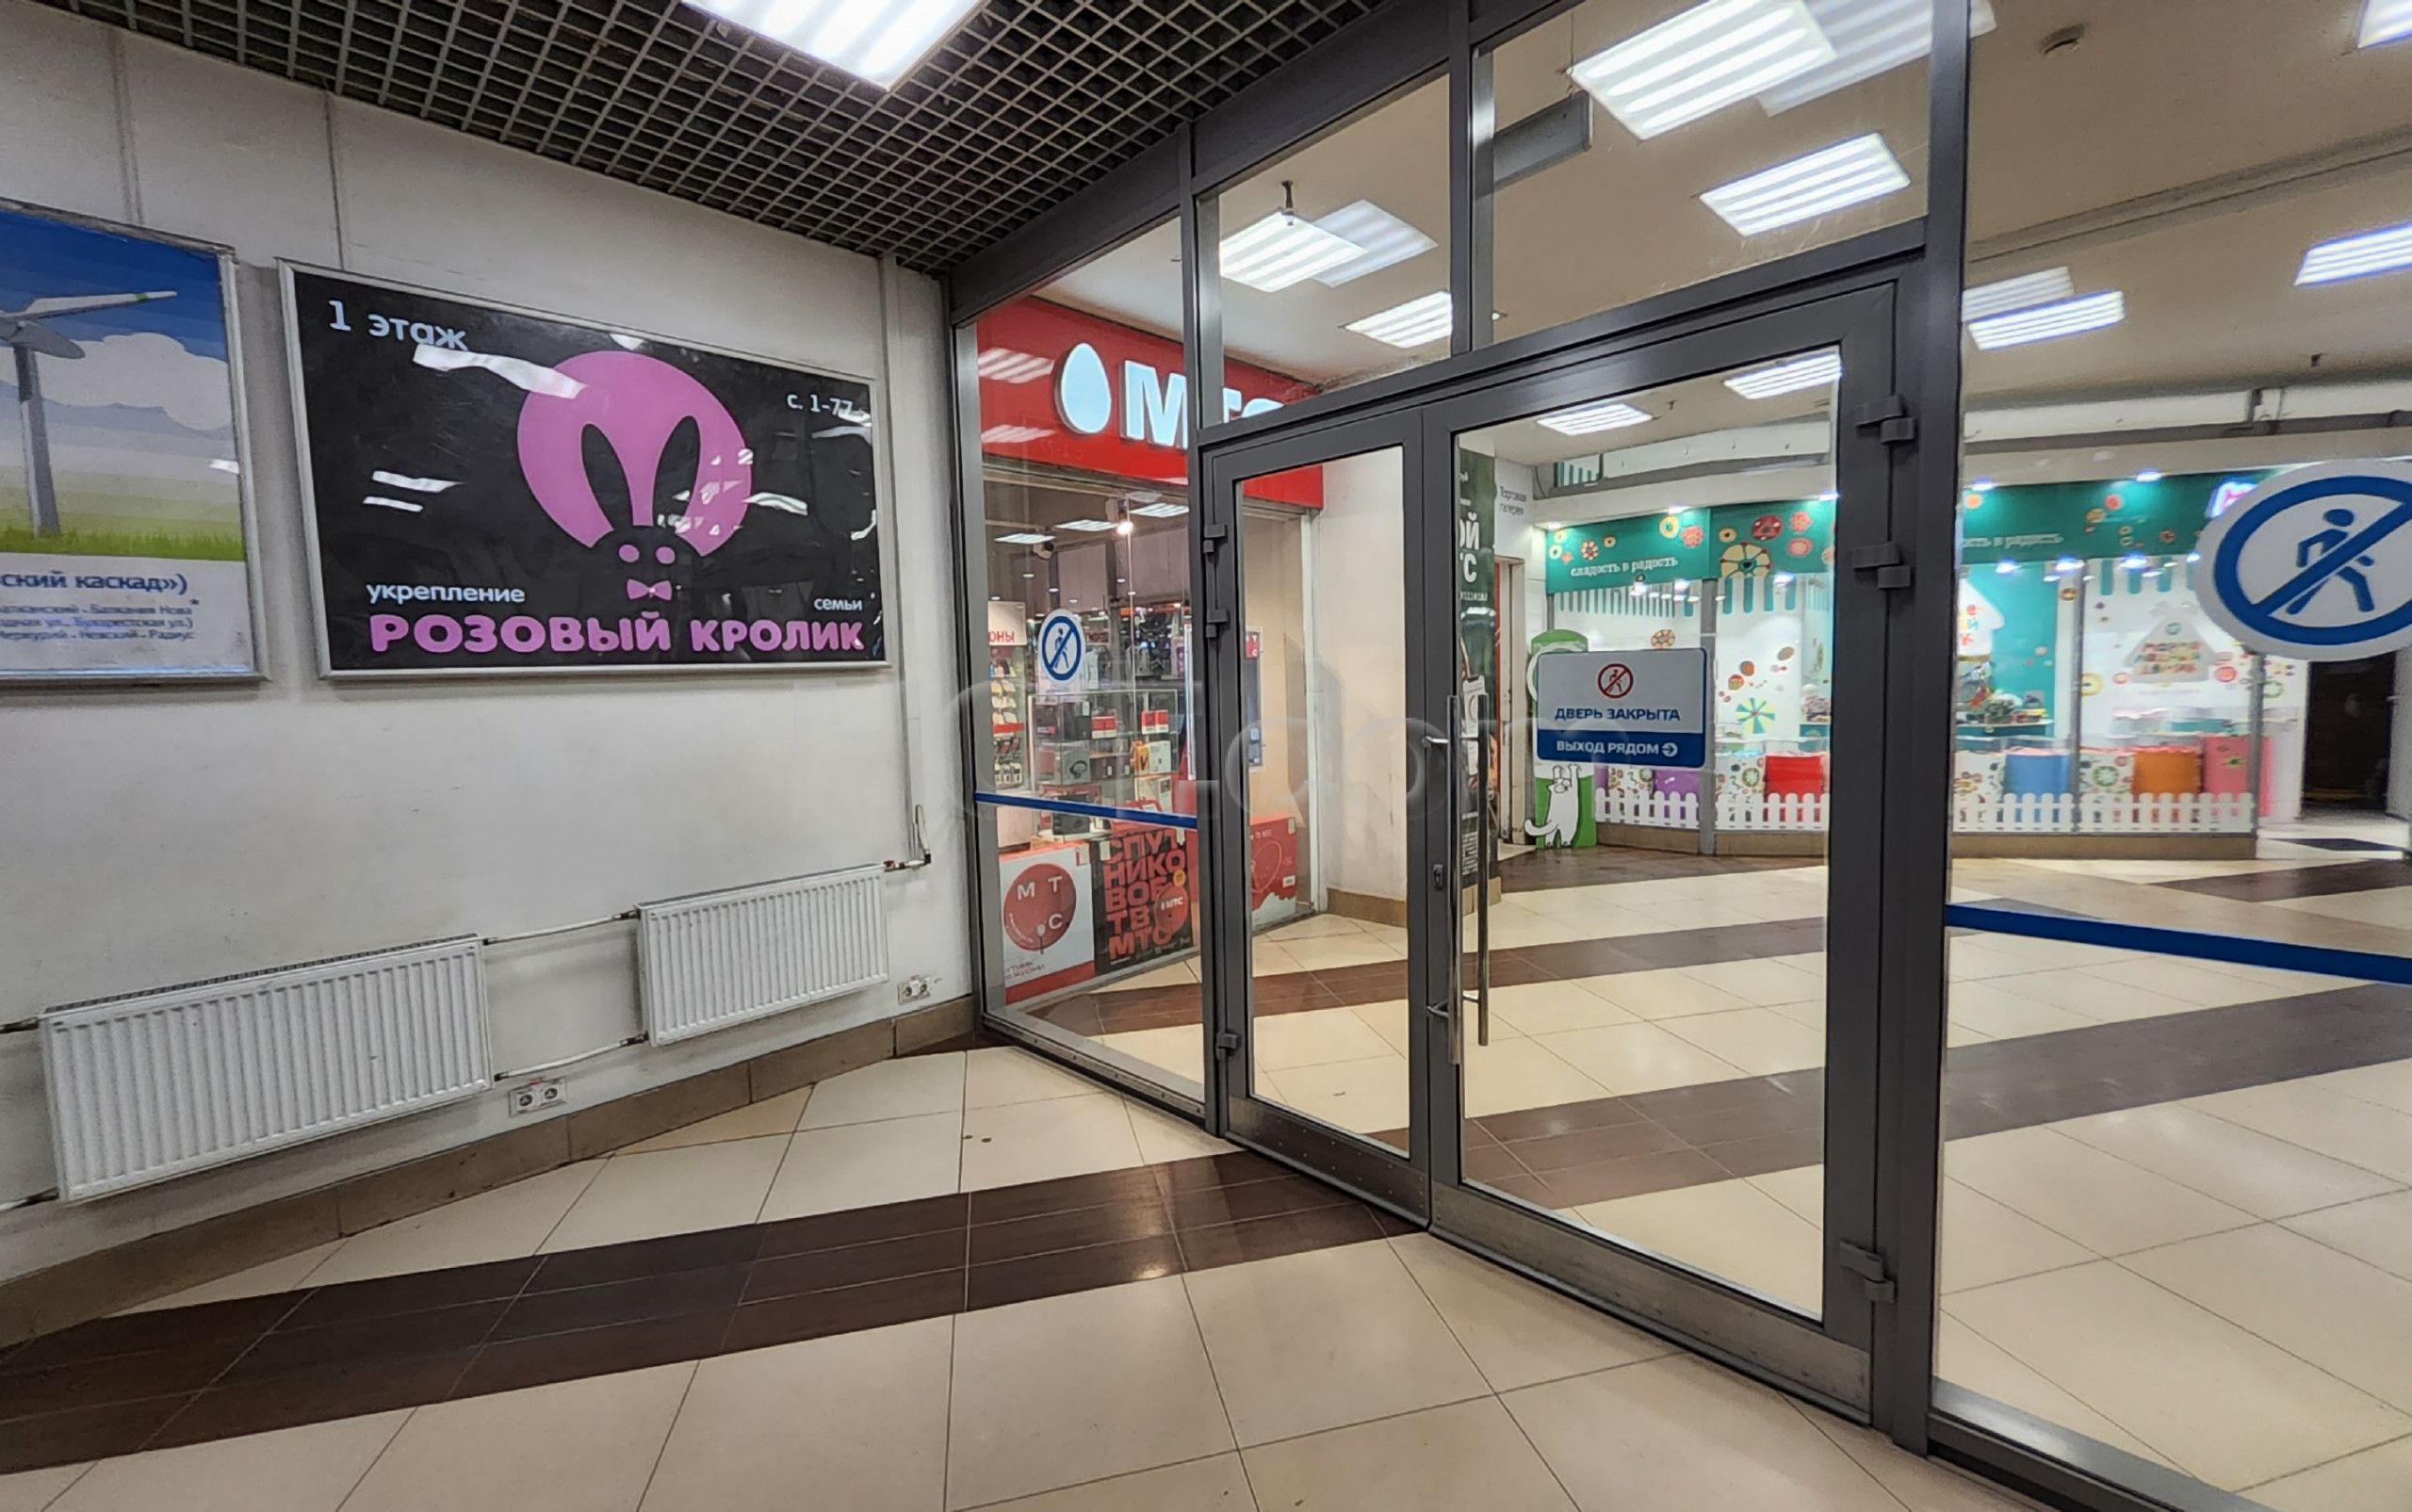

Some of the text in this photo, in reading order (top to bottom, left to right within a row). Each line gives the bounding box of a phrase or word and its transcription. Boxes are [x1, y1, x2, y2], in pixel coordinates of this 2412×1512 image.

[329, 300, 469, 351] 1 этаж
[1571, 563, 1622, 577] сладость
[1631, 557, 1679, 573] радость
[366, 584, 526, 605] укрепление
[813, 598, 863, 611] семьи
[369, 610, 865, 653] РОЗОВЫЙ КРОЛИК
[1555, 708, 1680, 722] ДВЕРЬ ЗАКРЫТА
[1556, 740, 1659, 756] ВЫХОД РЯДОМ
[1103, 848, 1186, 889] НИКО
[1107, 904, 1149, 935] ТВ
